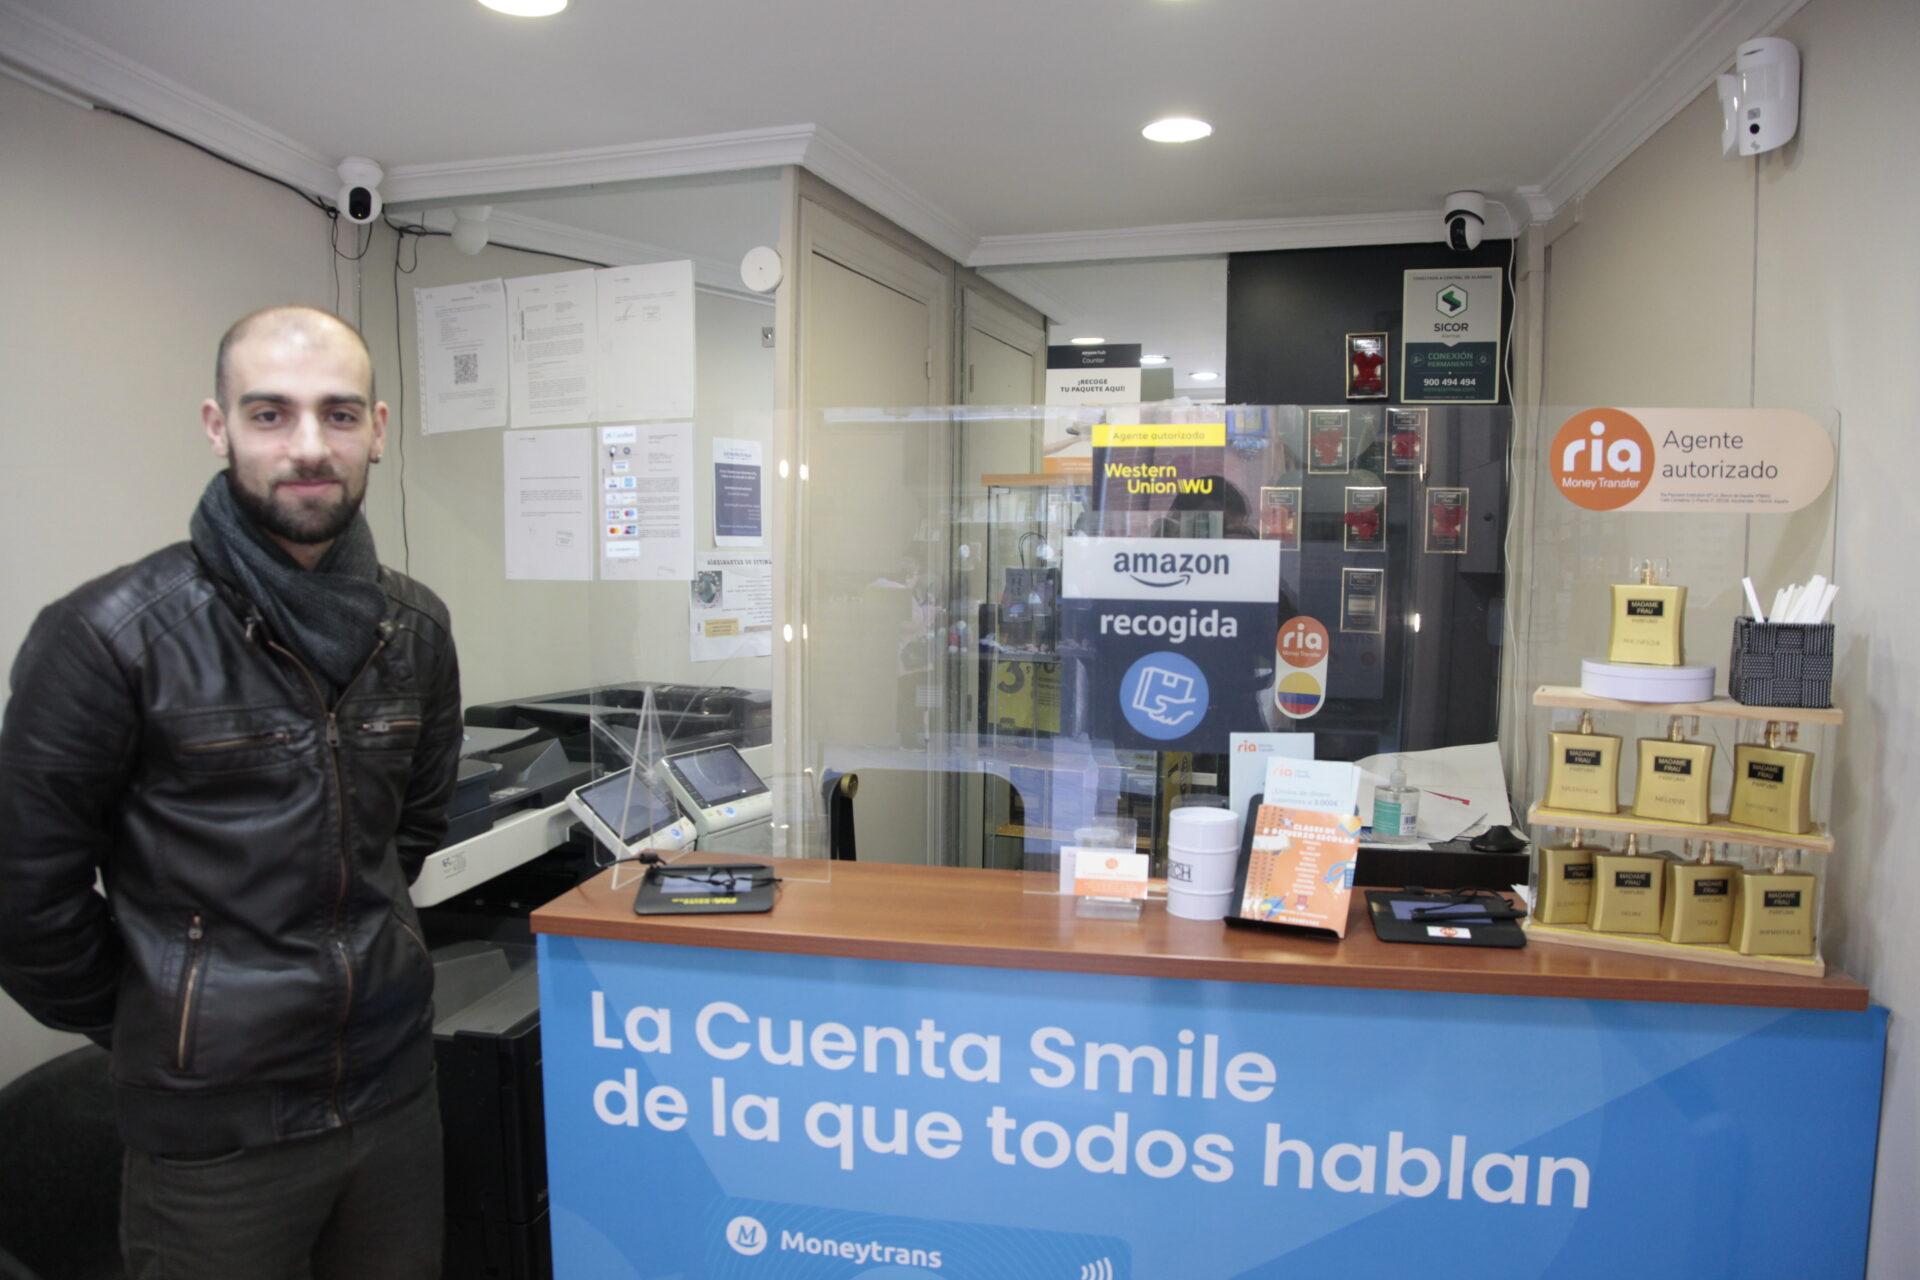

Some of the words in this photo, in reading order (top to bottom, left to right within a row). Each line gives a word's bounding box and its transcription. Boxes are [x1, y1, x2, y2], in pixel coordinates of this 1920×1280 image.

[1434, 323, 1469, 332] SICOR
[1428, 352, 1473, 360] CONEXIÓN
[1423, 378, 1440, 386] 900
[1441, 378, 1458, 386] 494
[1460, 378, 1476, 386] 494
[1112, 432, 1149, 442] Agente
[1150, 431, 1205, 440] autorizado
[1662, 430, 1743, 452] Agente
[1563, 421, 1642, 472] ria
[1104, 463, 1177, 478] Western
[1662, 460, 1778, 479] autorizado
[1127, 478, 1177, 494] Union
[1181, 478, 1213, 494] WU
[1562, 477, 1598, 490] Money
[1597, 477, 1640, 488] Transfer
[1113, 551, 1230, 575] amazon
[1100, 608, 1238, 643] recogida
[1283, 623, 1322, 650] ria
[1236, 739, 1257, 752] ria
[1569, 750, 1596, 758] MADAME
[1658, 758, 1686, 766] MADAME
[1272, 764, 1293, 777] ria
[591, 991, 671, 1054] La
[696, 1001, 1000, 1083] Cuenta
[1030, 1026, 1276, 1102] Smile
[593, 1068, 688, 1131] de
[712, 1076, 780, 1142] la
[804, 1101, 963, 1170] que
[986, 1106, 1234, 1183] todos
[1263, 1122, 1590, 1209] hablan
[781, 1230, 942, 1268] Moneytrans
